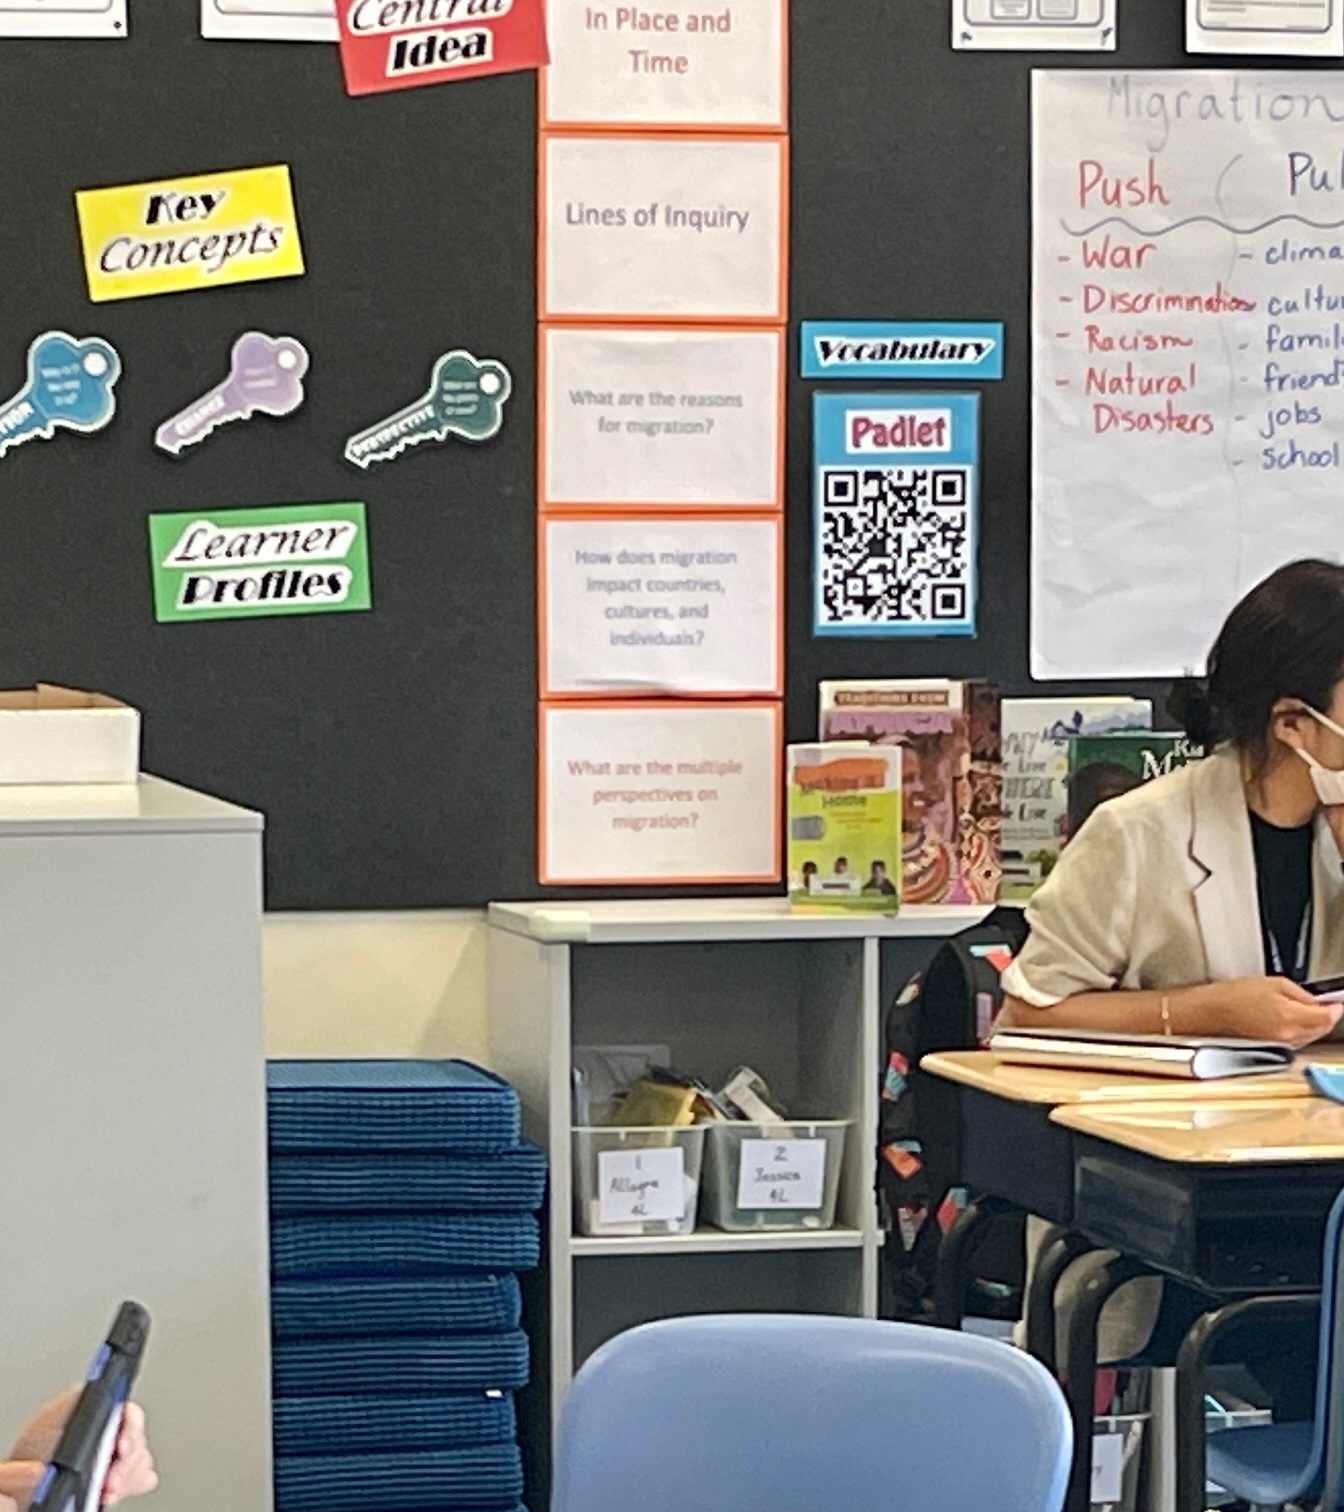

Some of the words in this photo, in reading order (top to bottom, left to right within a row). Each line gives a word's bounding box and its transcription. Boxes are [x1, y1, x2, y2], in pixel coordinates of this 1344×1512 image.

[586, 10, 607, 31] In
[616, 8, 680, 32] Place
[686, 9, 731, 33] and
[392, 32, 487, 71] Idea
[629, 50, 689, 75] Time
[1077, 157, 1171, 208] Push
[145, 189, 227, 224] Key
[566, 203, 626, 227] Lines
[633, 203, 659, 227] of
[664, 204, 750, 234] Inquiry
[100, 222, 284, 273] Concepts
[1082, 235, 1158, 270] War
[818, 339, 993, 364] Vocabulary
[1086, 324, 1193, 352] Racism
[1086, 362, 1196, 396] Natural
[569, 390, 613, 407] What
[618, 394, 644, 407] are
[649, 390, 676, 408] the
[679, 393, 743, 408] reasons
[598, 417, 622, 433] for
[626, 417, 714, 436] migration?
[1093, 402, 1214, 433] Disasters
[1260, 400, 1322, 438] jobs
[850, 416, 947, 448] Padlet
[1262, 442, 1339, 470] school
[173, 522, 349, 563] Learner
[575, 549, 612, 565] How
[617, 549, 655, 565] does
[660, 549, 737, 568] migration
[182, 570, 343, 605] Profiles
[586, 577, 642, 595] impact
[646, 577, 726, 595] countries,
[605, 604, 673, 621] cultures,
[678, 604, 709, 620] and
[609, 629, 704, 646] individuals?
[568, 760, 611, 777] What
[616, 763, 642, 777] are
[646, 760, 673, 777] the
[677, 760, 743, 779] multiple
[592, 786, 694, 806] perspectives
[698, 789, 718, 803] on
[611, 813, 699, 832] migration?
[774, 1145, 789, 1161] 2
